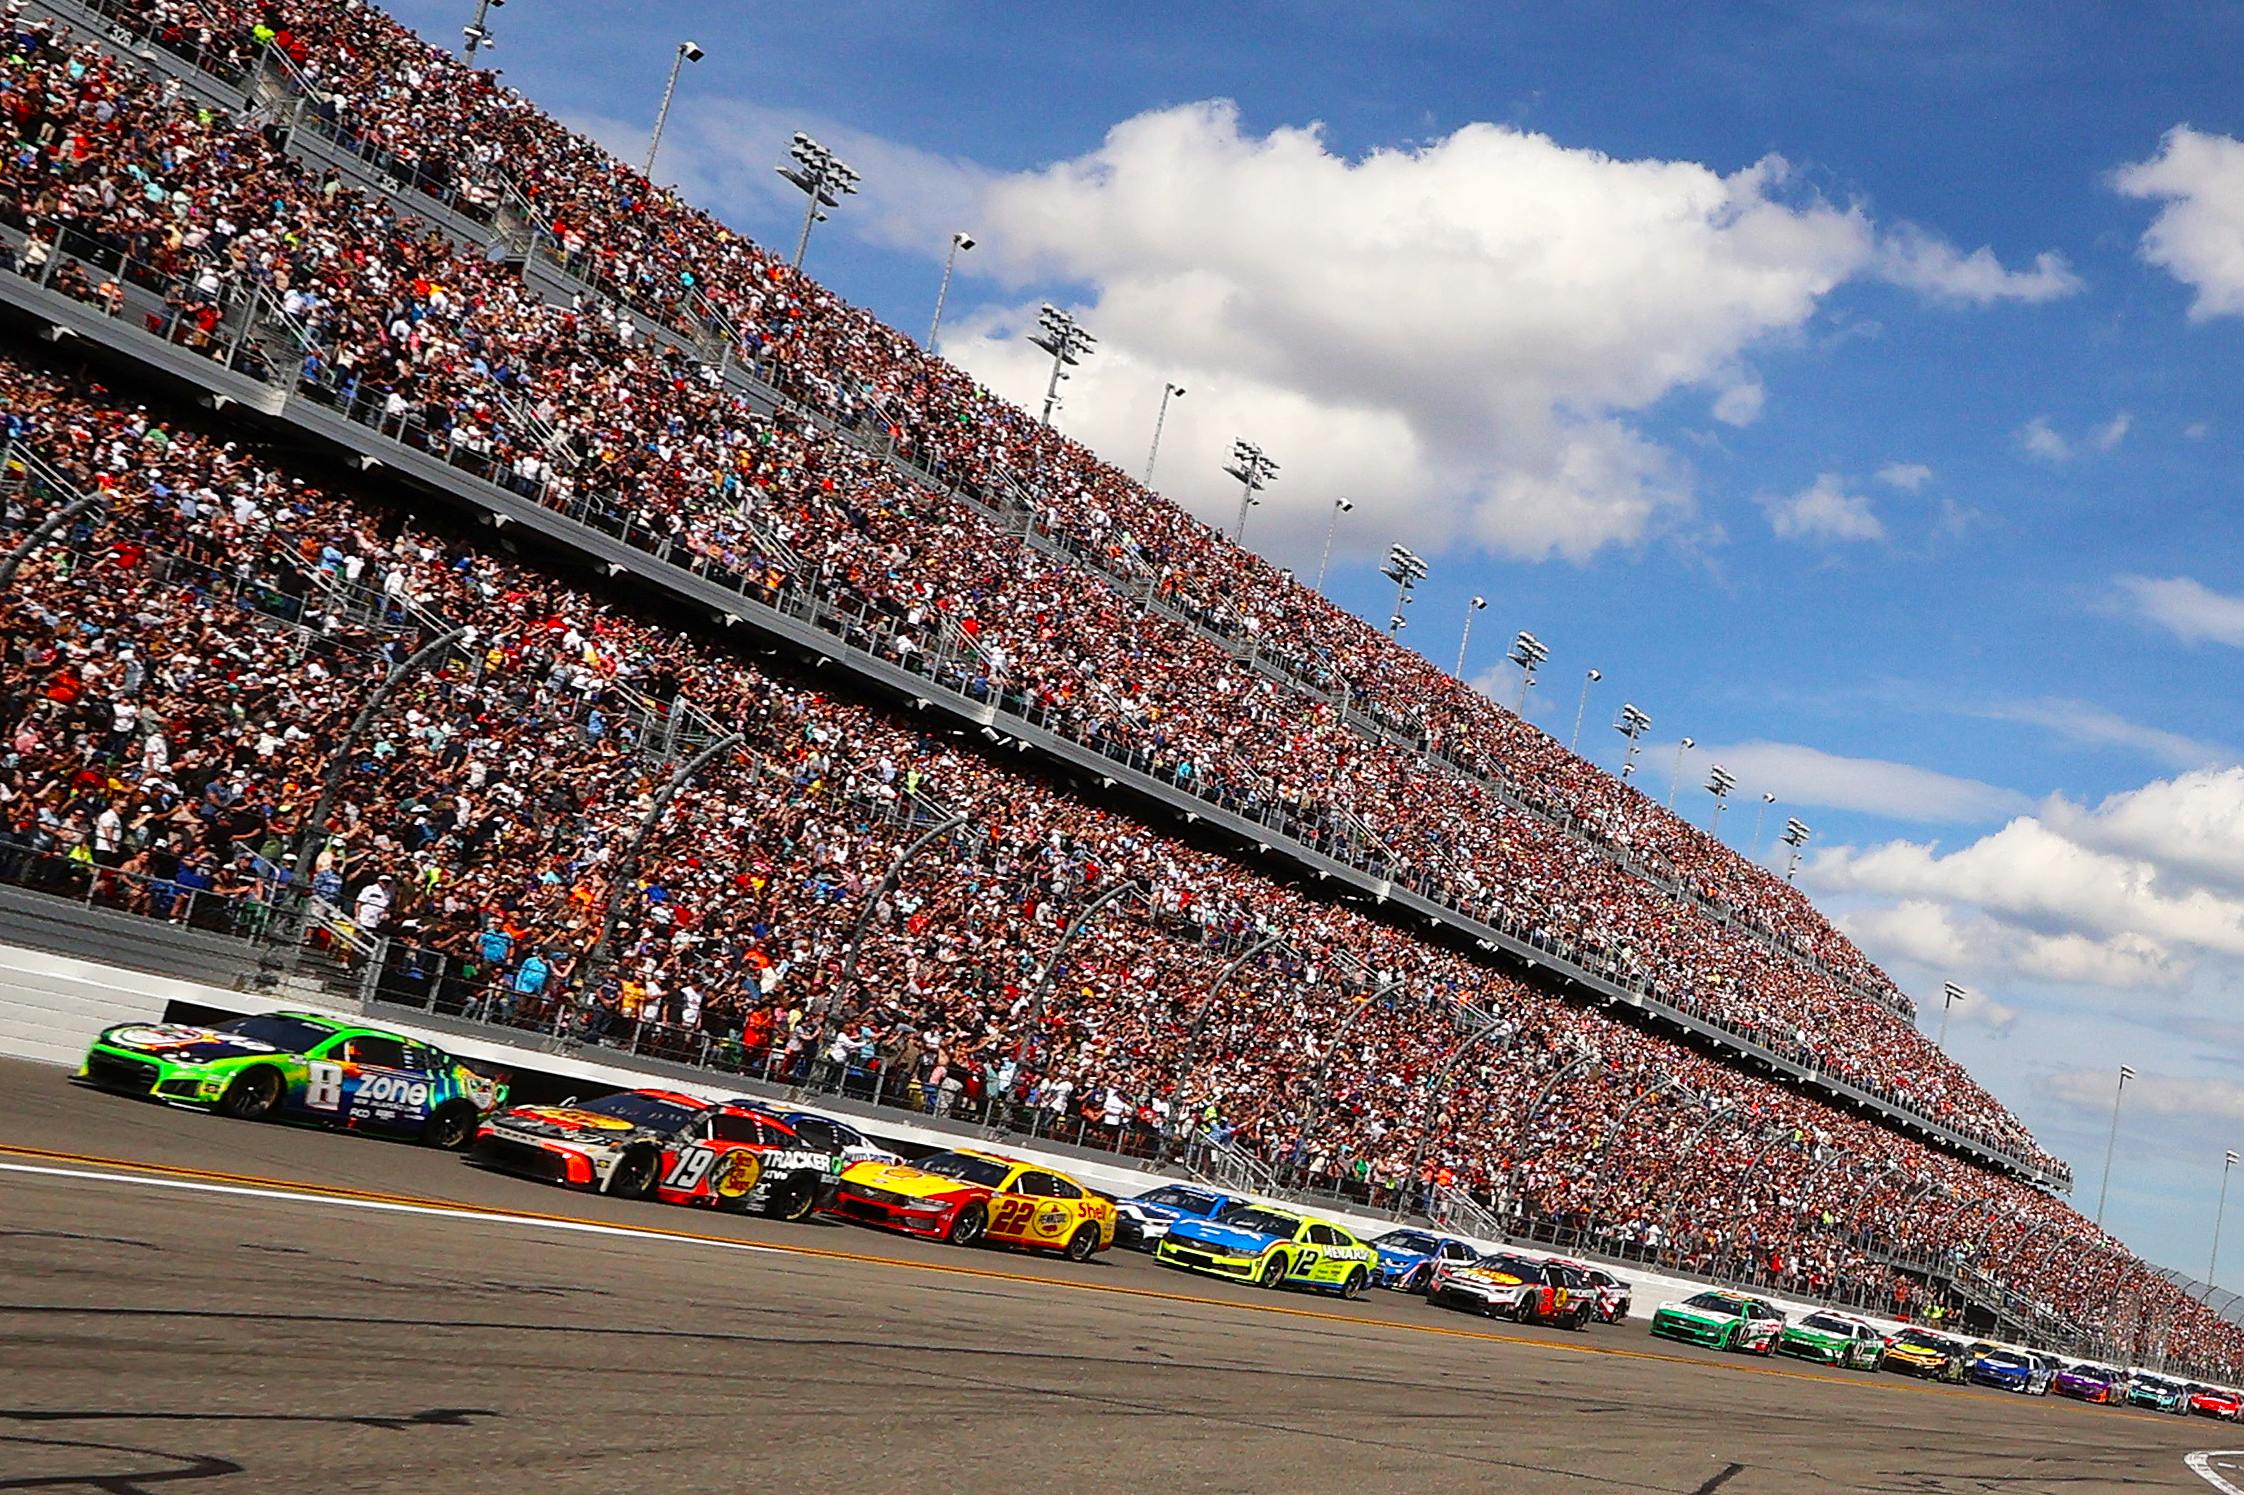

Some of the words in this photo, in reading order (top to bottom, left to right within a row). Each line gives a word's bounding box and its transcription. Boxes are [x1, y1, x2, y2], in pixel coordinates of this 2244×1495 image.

[305, 1061, 342, 1110] 8
[354, 1073, 427, 1105] zone
[665, 1148, 713, 1187] 19
[762, 1150, 832, 1173] TRACKER
[991, 1200, 1035, 1235] 22
[1078, 1201, 1107, 1220] Shell
[1290, 1249, 1318, 1276] 12
